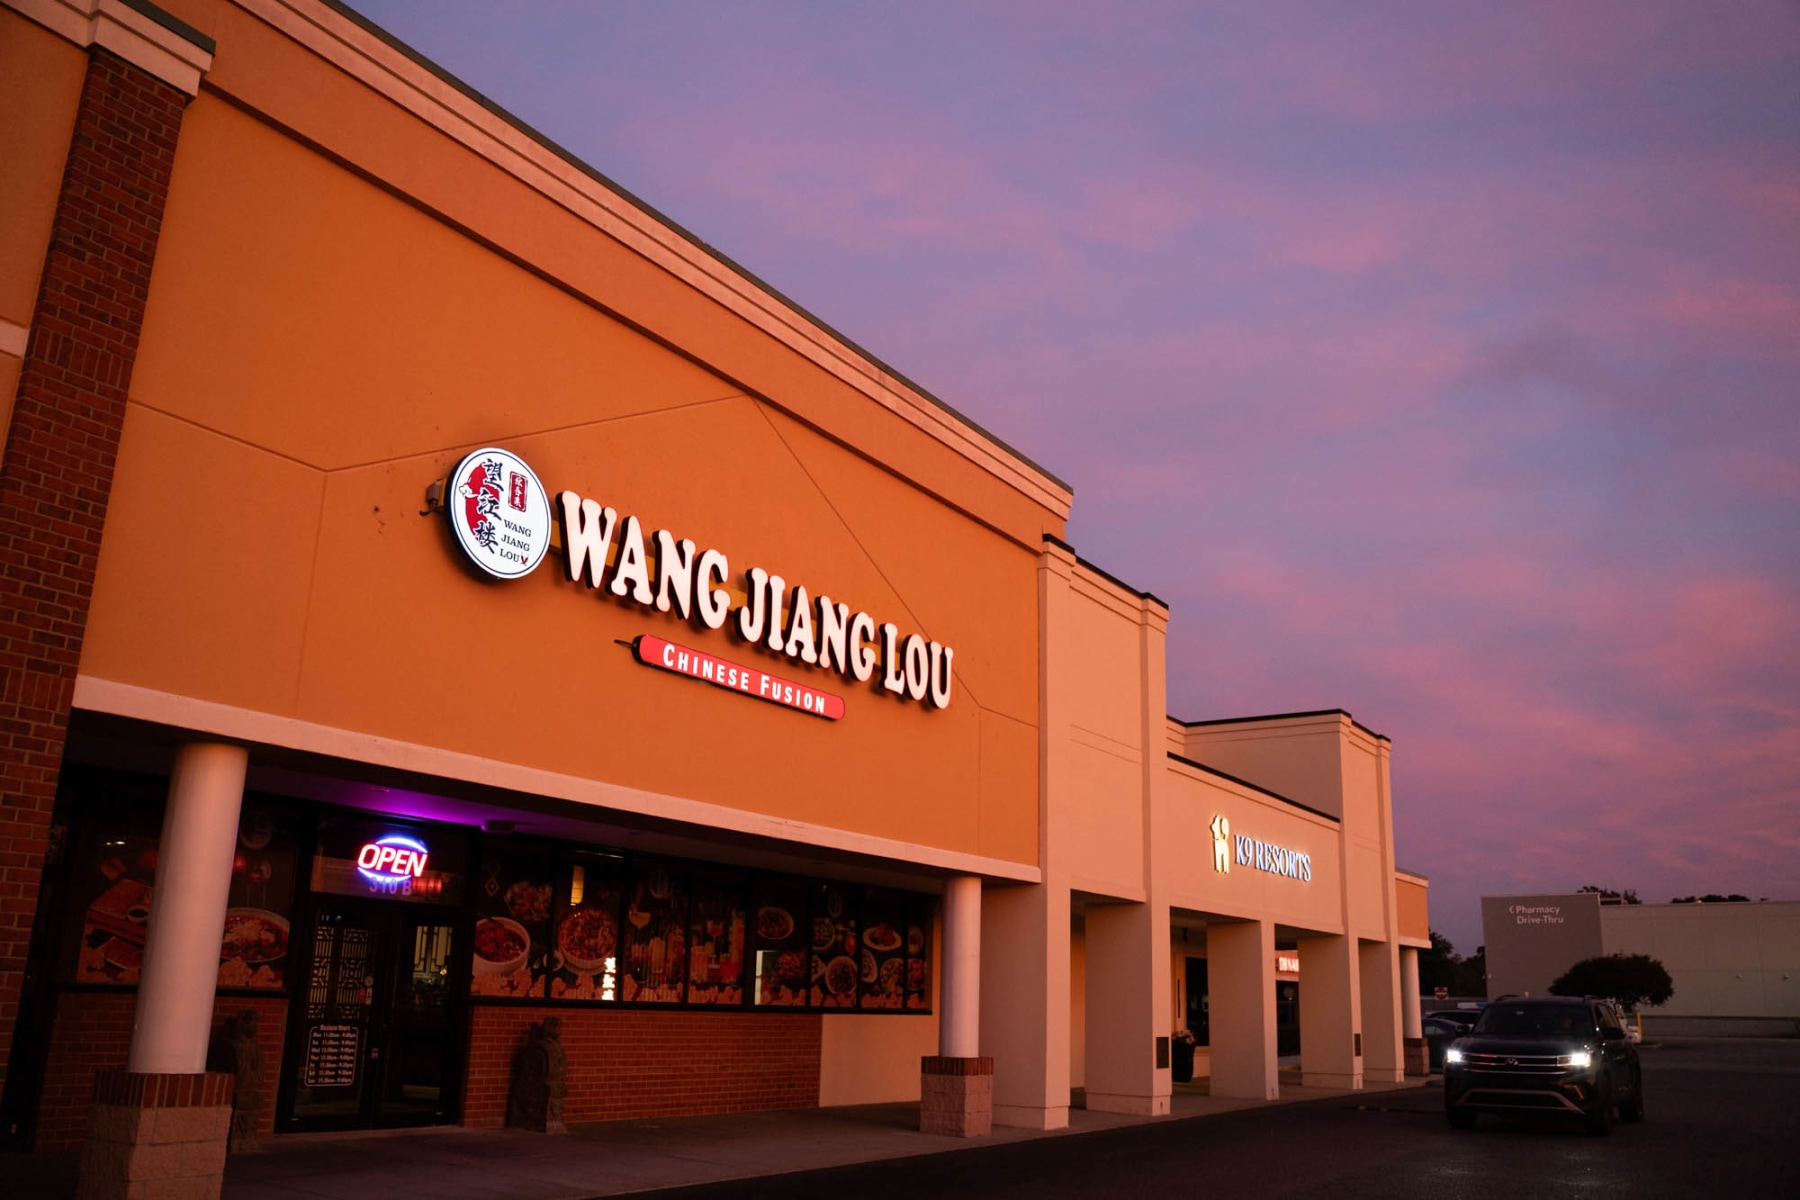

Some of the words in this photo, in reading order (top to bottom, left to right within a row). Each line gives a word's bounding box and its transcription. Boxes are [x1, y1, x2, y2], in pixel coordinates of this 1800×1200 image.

[503, 518, 532, 537] WANG
[501, 534, 531, 552] JIANG
[499, 548, 521, 563] LOU
[561, 489, 731, 629] WANG
[740, 566, 876, 682] JIANG
[883, 622, 954, 710] LOU
[662, 642, 750, 690] CHINESE
[760, 674, 826, 714] FUSION
[357, 843, 428, 878] OPEN
[1235, 834, 1254, 866] K9
[1255, 840, 1312, 882] RESORTS
[1515, 905, 1560, 916] Pharmacy
[1516, 915, 1564, 925] Drive-Thru
